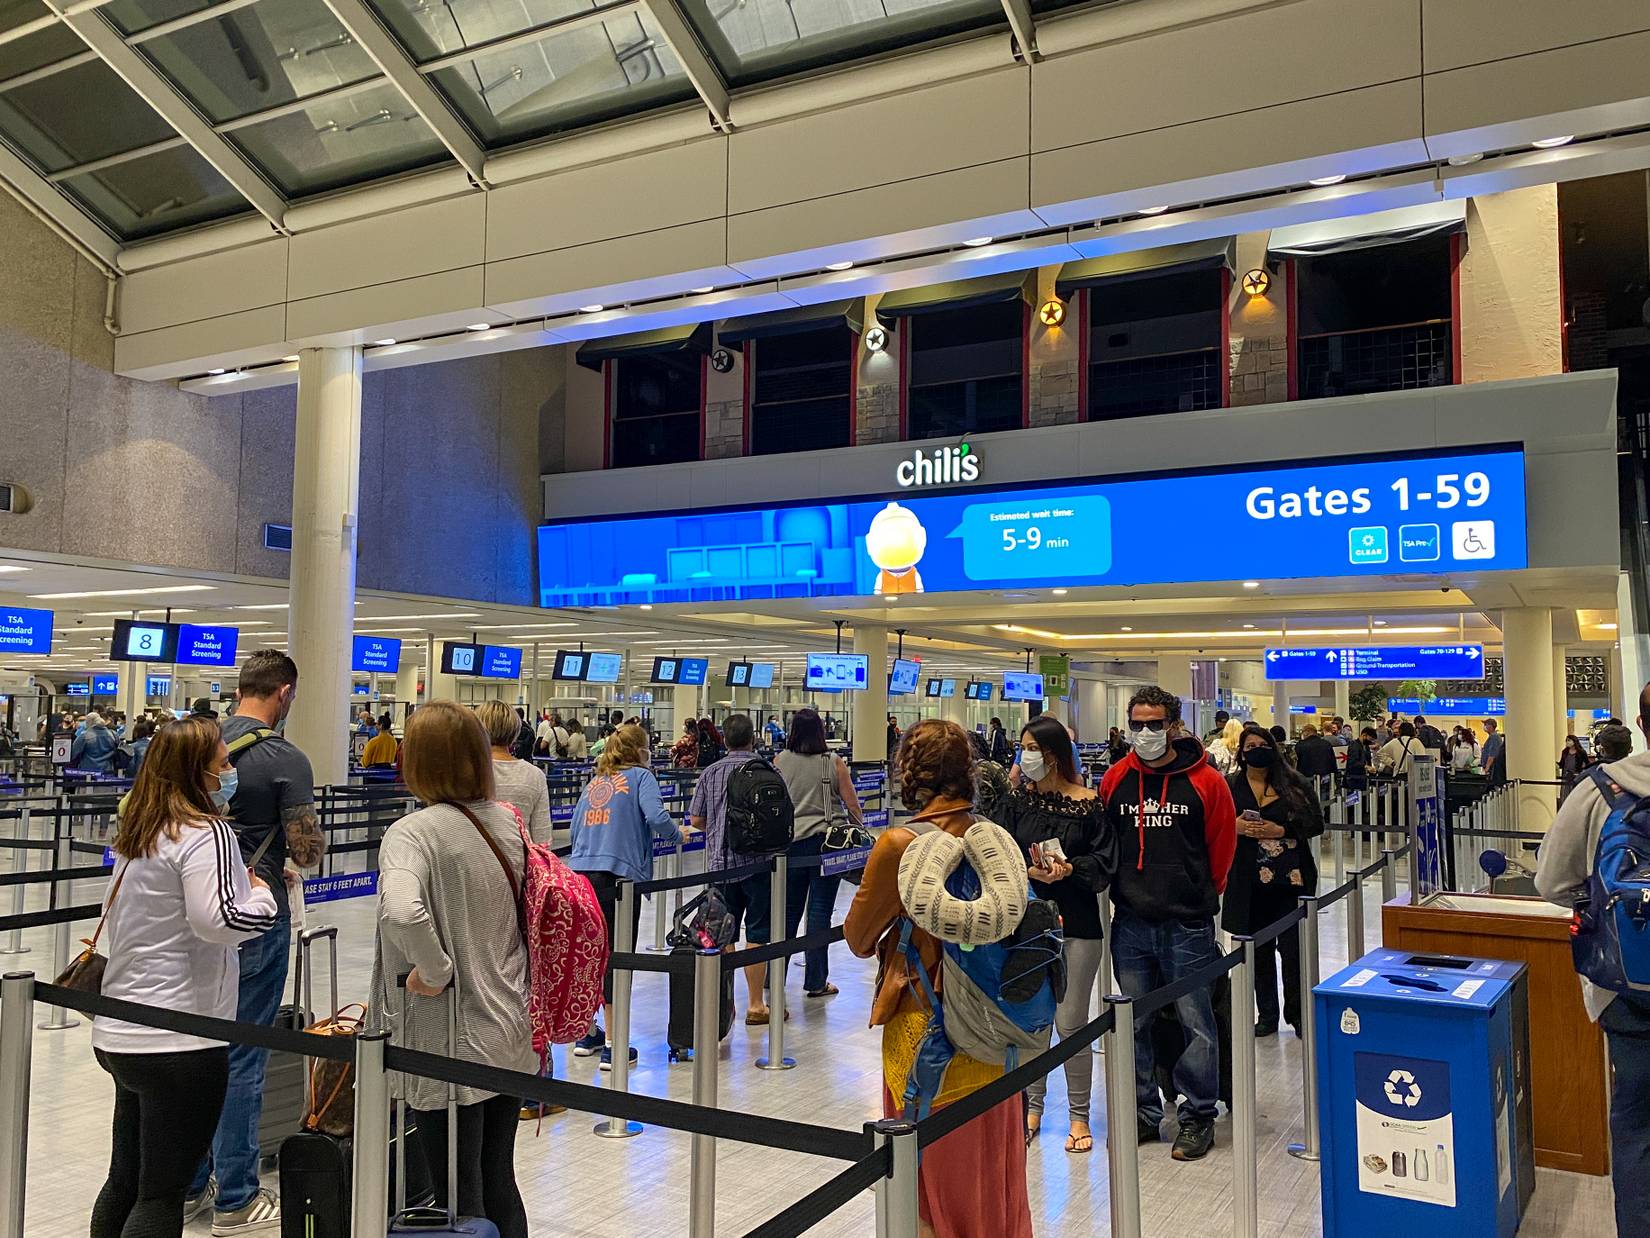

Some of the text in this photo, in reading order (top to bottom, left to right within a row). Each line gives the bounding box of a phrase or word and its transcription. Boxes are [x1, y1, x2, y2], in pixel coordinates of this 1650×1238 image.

[896, 442, 979, 487] chili's
[1245, 471, 1490, 520] Gates 1-59
[989, 507, 1075, 522] Estimated wait time:
[1002, 526, 1069, 551] 5-9 min
[8, 616, 24, 624] TSA
[0, 636, 33, 646] creening
[139, 634, 152, 650] 8
[202, 632, 215, 641] TSA
[193, 641, 222, 650] Standard
[372, 643, 383, 651] TSA
[191, 650, 222, 660] Screening
[364, 650, 388, 659] Standard
[455, 653, 472, 666] 10
[363, 658, 388, 668] Screening
[566, 660, 578, 672] 11
[662, 661, 674, 675] 12
[1120, 802, 1189, 815] I'M HER
[584, 808, 611, 826] 1986
[1134, 815, 1172, 827] KING
[304, 876, 372, 894] ASE STAY 6 FEET APART.
